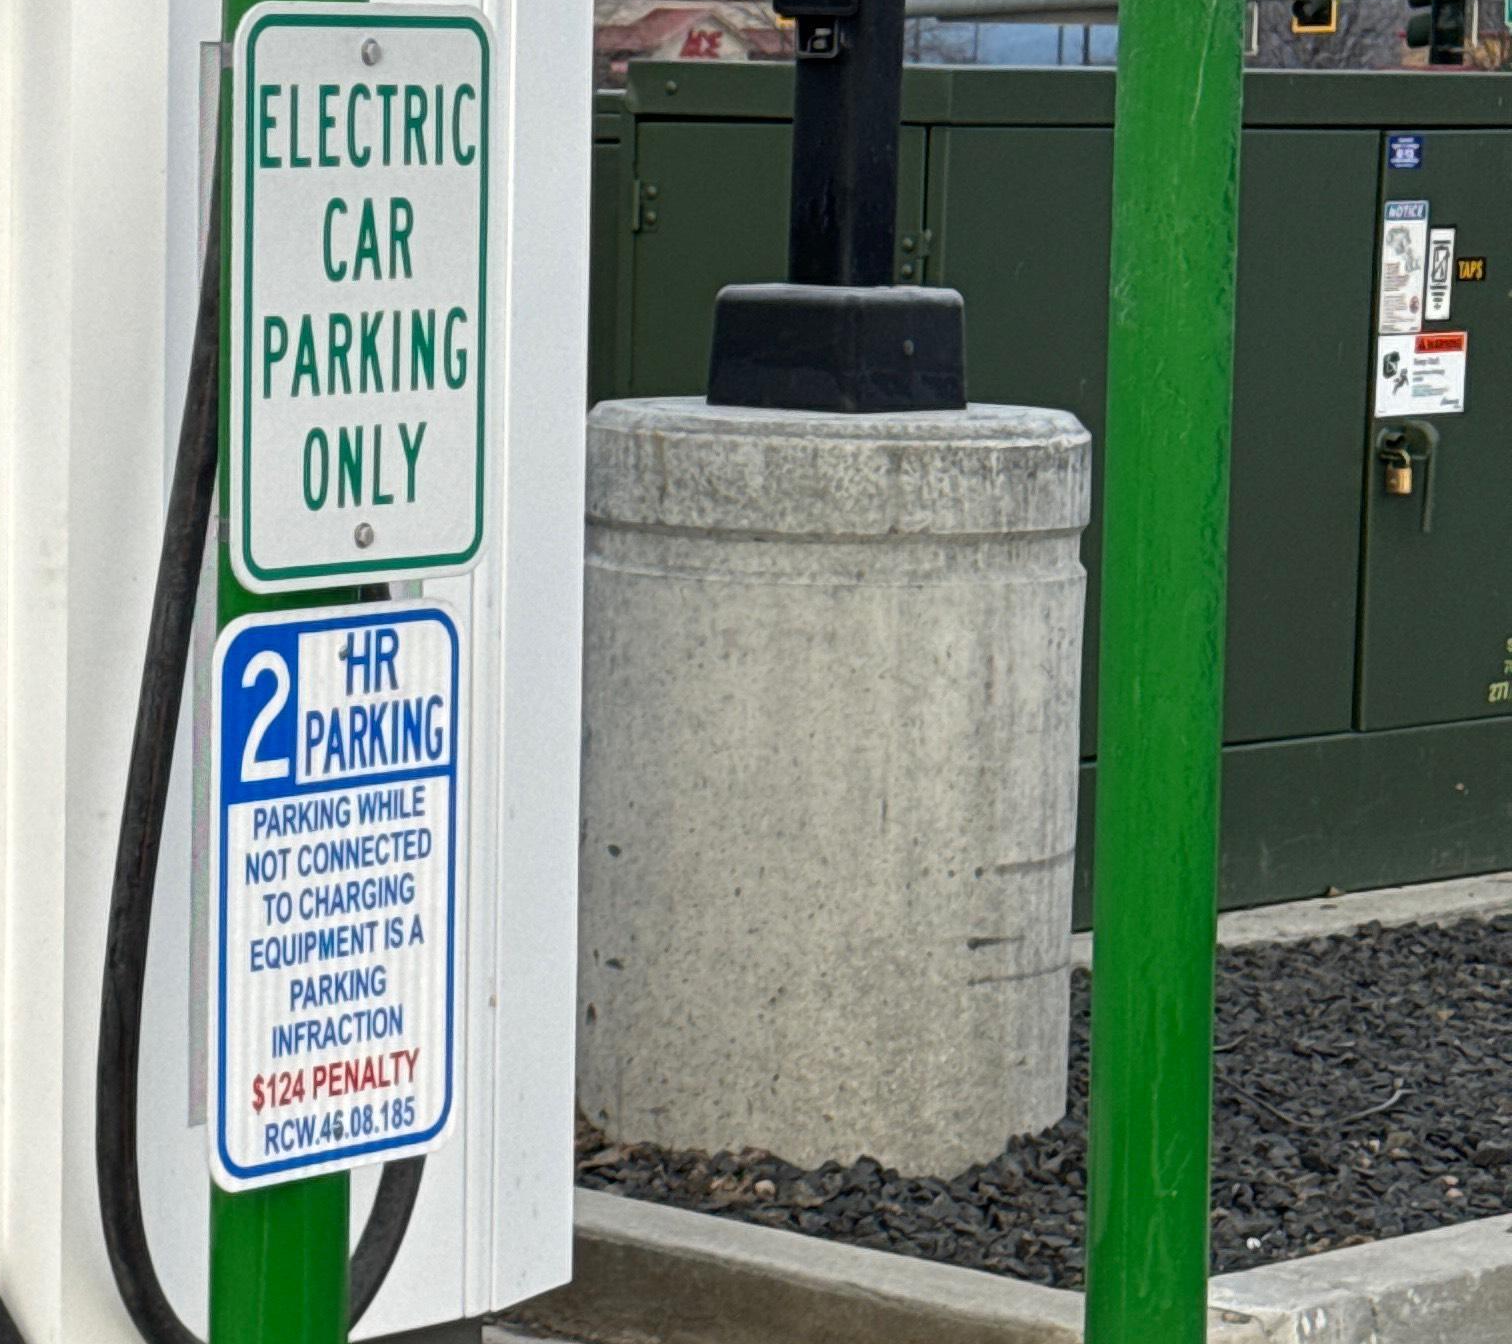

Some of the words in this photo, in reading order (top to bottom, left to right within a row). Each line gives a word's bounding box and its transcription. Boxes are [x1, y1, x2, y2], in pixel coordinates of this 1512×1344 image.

[260, 83, 476, 168] ELECTRIC
[323, 197, 414, 282] CAR
[263, 306, 467, 399] PARKING
[303, 421, 427, 511] ONLY
[241, 650, 291, 782] 2
[346, 628, 400, 696] HR
[305, 695, 444, 776] PARKING
[253, 796, 351, 840] PARKING
[357, 785, 425, 825] WHILE
[245, 847, 292, 885] NOT
[297, 828, 432, 877] CONNECTED
[263, 892, 292, 926] TO
[299, 872, 415, 920] CHARGING
[250, 920, 378, 972] EQUIPMENT
[384, 917, 404, 950] IS
[408, 913, 424, 945] A
[290, 965, 387, 1012] PARKING
[272, 1003, 404, 1058] INFRACTION
[252, 1069, 305, 1115] $124
[313, 1048, 420, 1100] PENALTY
[264, 1096, 416, 1156] RCW.46.08.185
